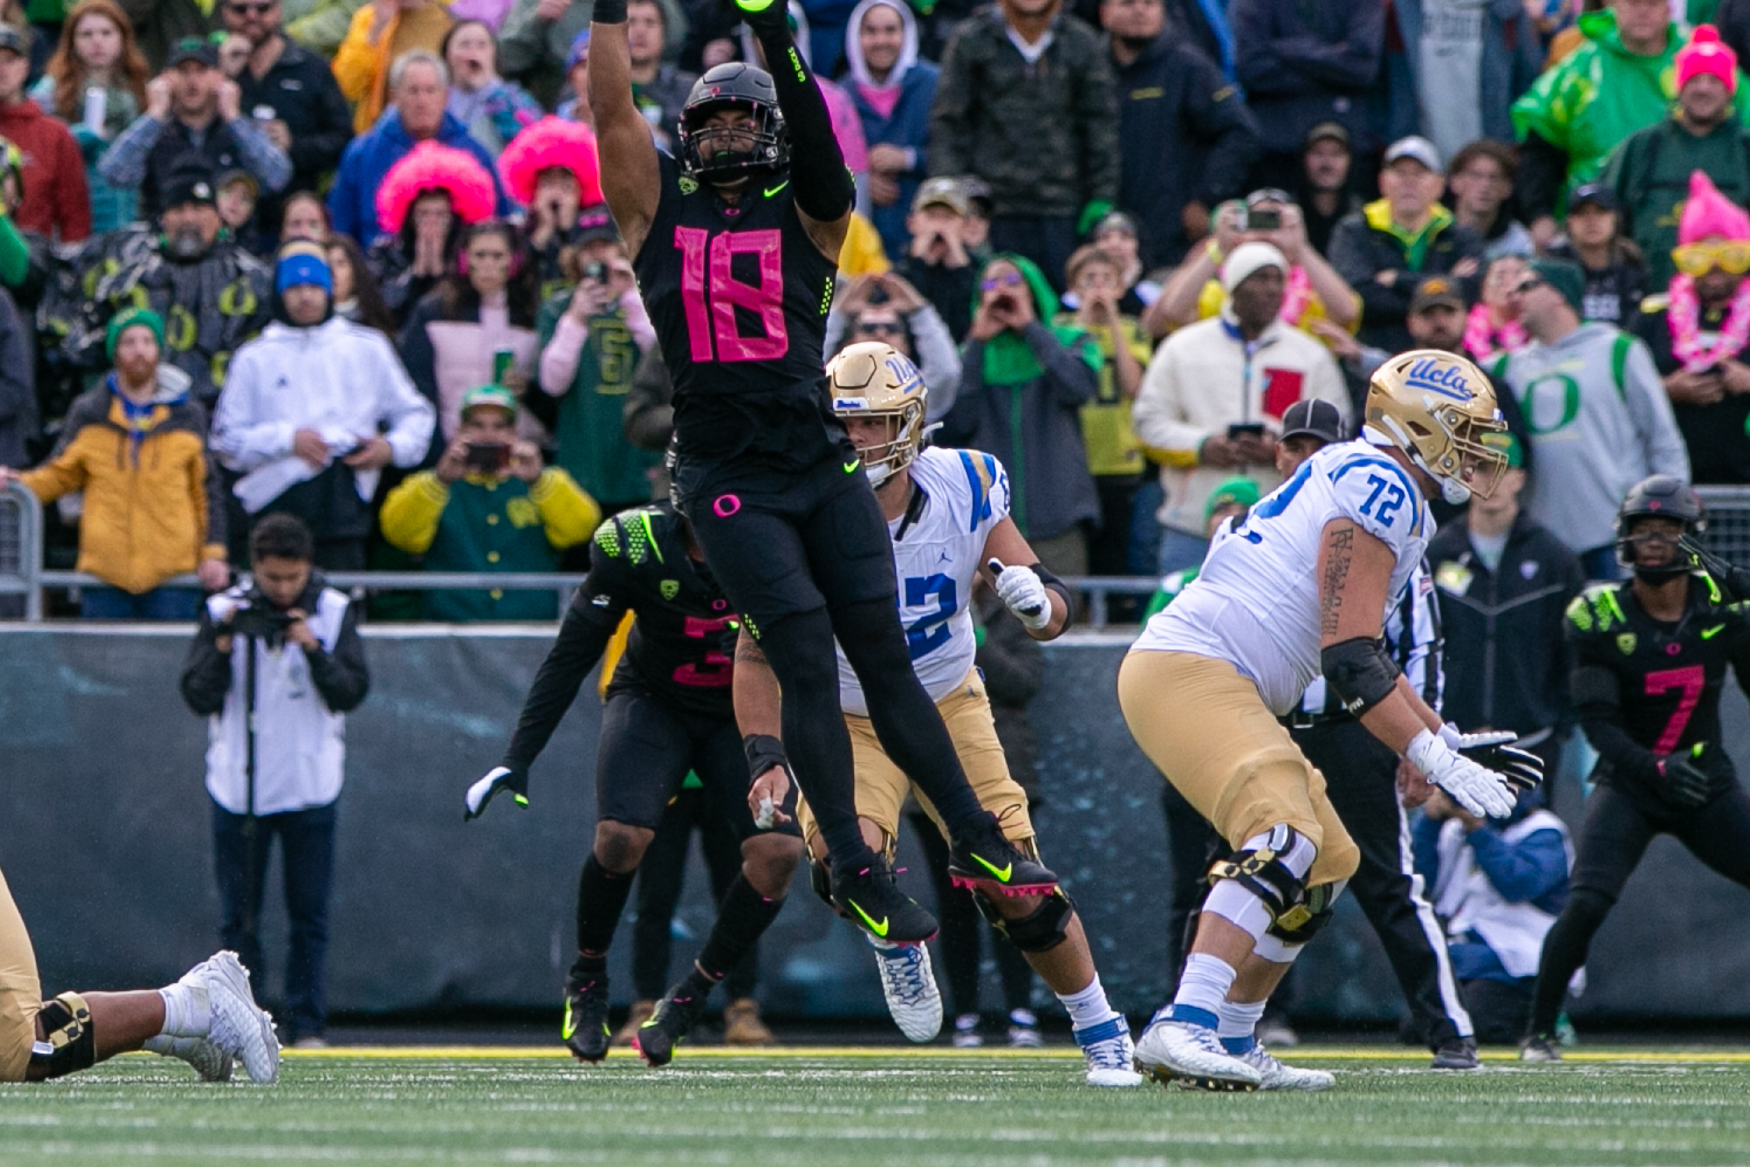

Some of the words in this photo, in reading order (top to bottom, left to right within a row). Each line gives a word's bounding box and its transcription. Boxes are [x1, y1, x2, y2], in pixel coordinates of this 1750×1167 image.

[787, 46, 802, 71] DUCKS
[797, 69, 806, 83] GO
[674, 226, 789, 363] 18
[1519, 374, 1579, 434] O
[713, 494, 741, 518] O
[1359, 473, 1405, 529] 72
[896, 573, 957, 662] 2
[673, 614, 739, 687] 3
[1644, 665, 1705, 756] 7
